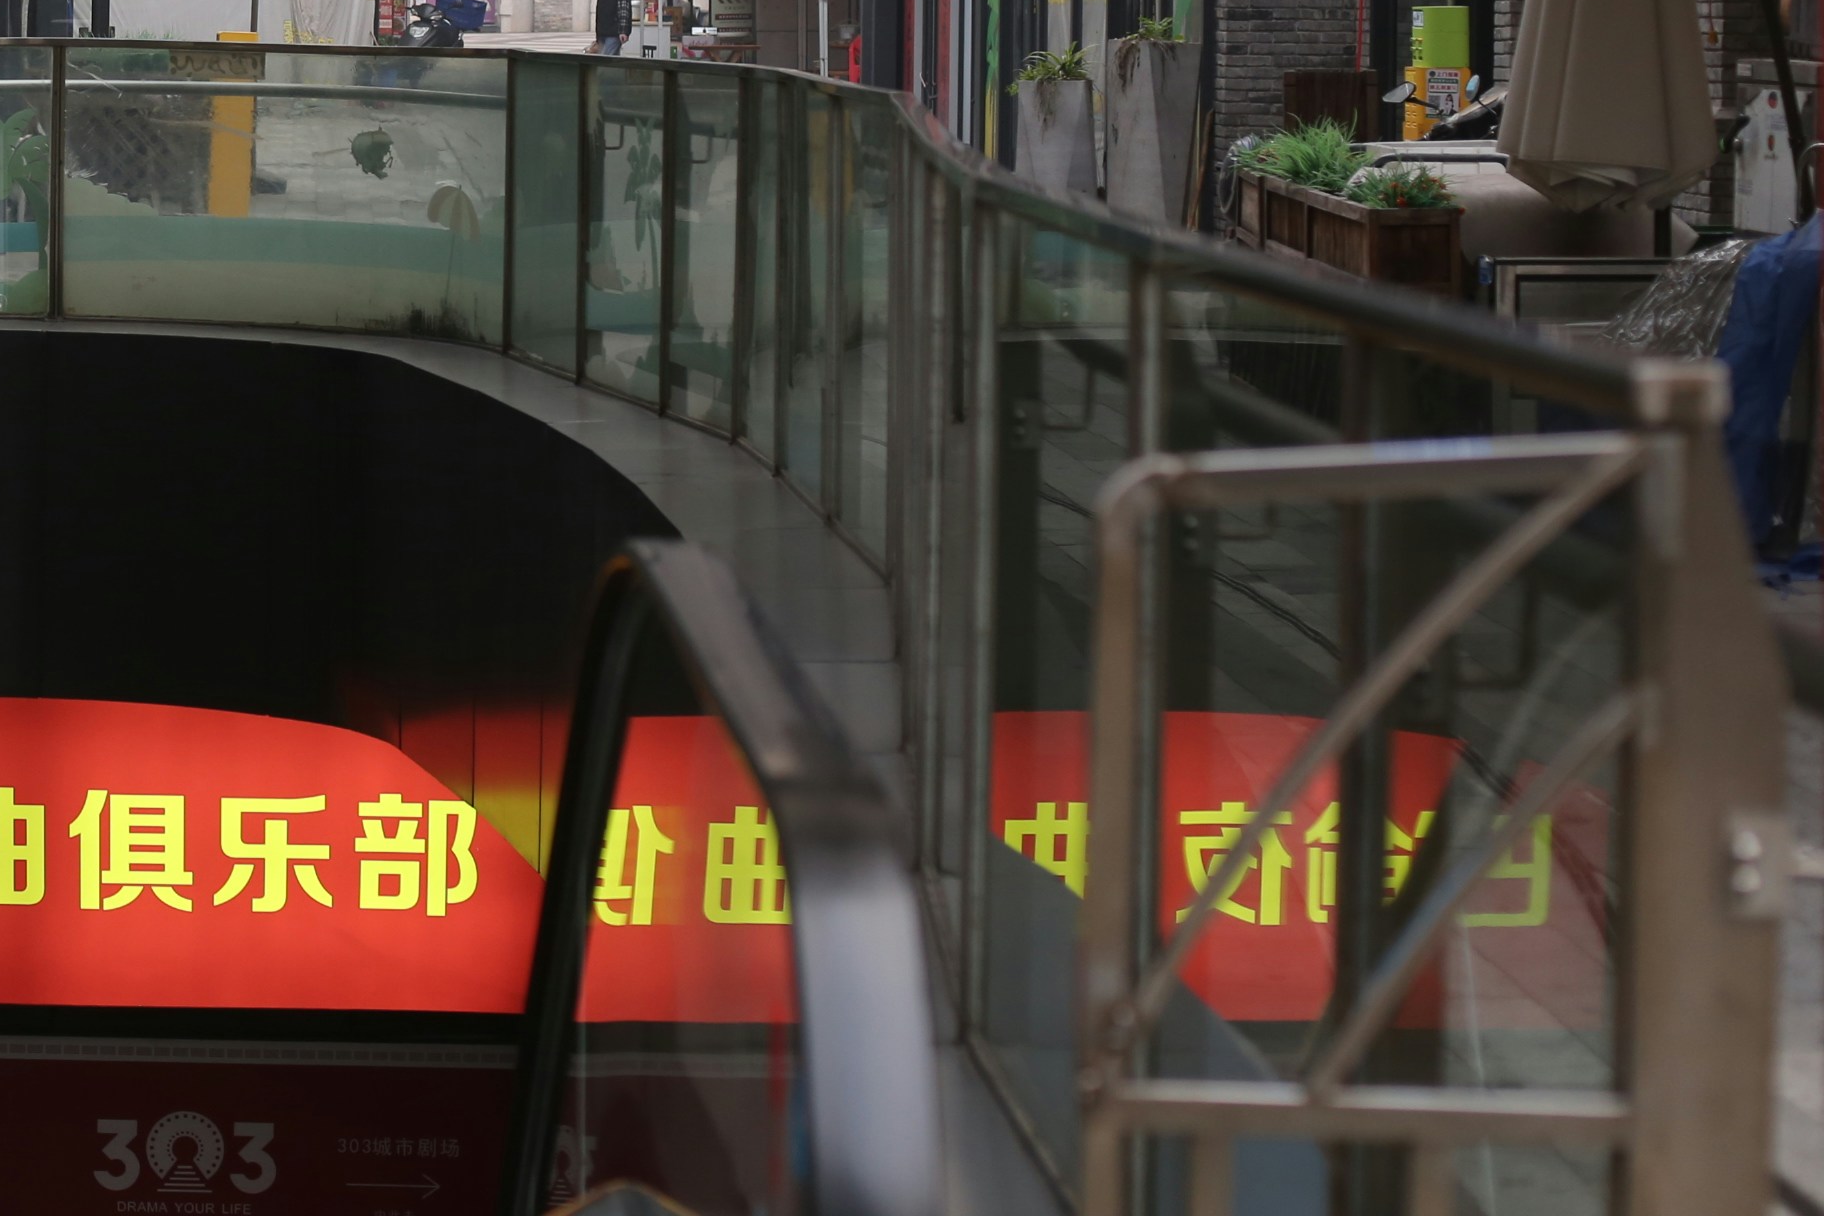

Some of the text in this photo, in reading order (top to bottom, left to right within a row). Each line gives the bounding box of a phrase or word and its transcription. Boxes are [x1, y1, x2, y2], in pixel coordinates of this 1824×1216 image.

[337, 1137, 461, 1159] 303城市剧场
[116, 1200, 252, 1216] DRAMA YOUR LIFE
